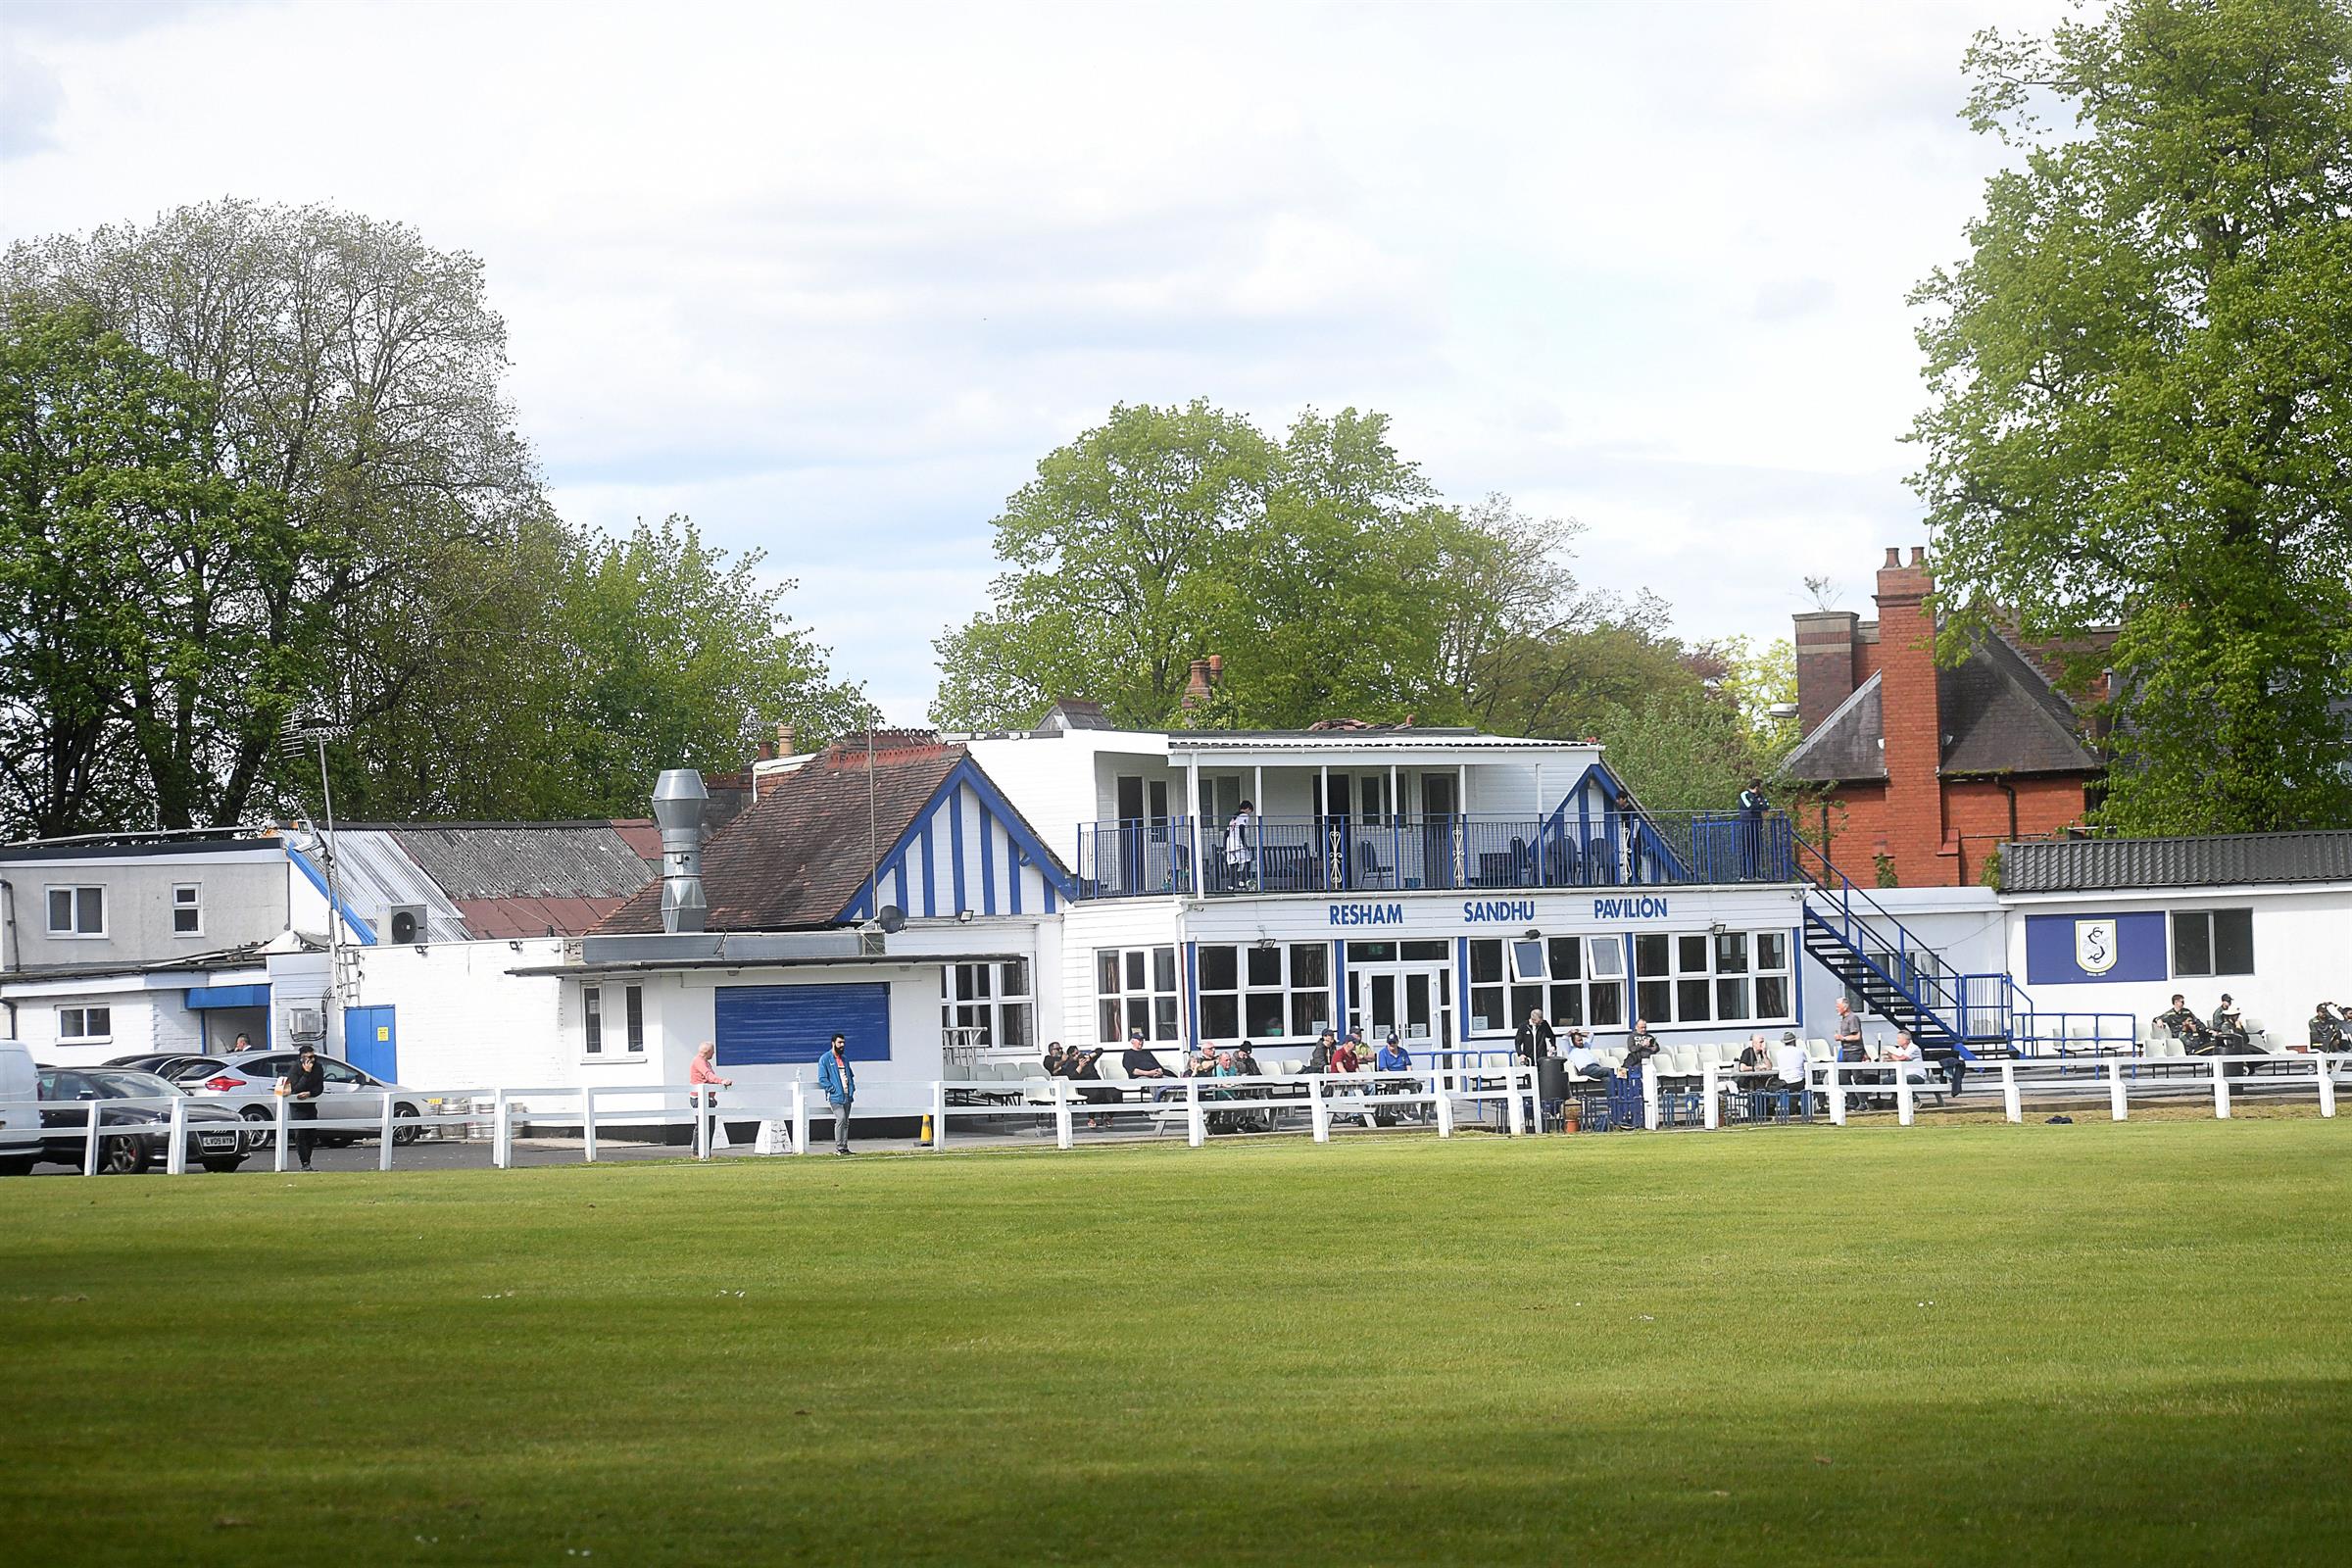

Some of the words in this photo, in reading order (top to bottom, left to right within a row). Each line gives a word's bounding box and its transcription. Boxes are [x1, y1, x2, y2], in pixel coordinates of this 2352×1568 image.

[1330, 905, 1403, 925] RESHAM
[1464, 902, 1535, 922] SANDHU
[1593, 898, 1668, 918] PAVILION
